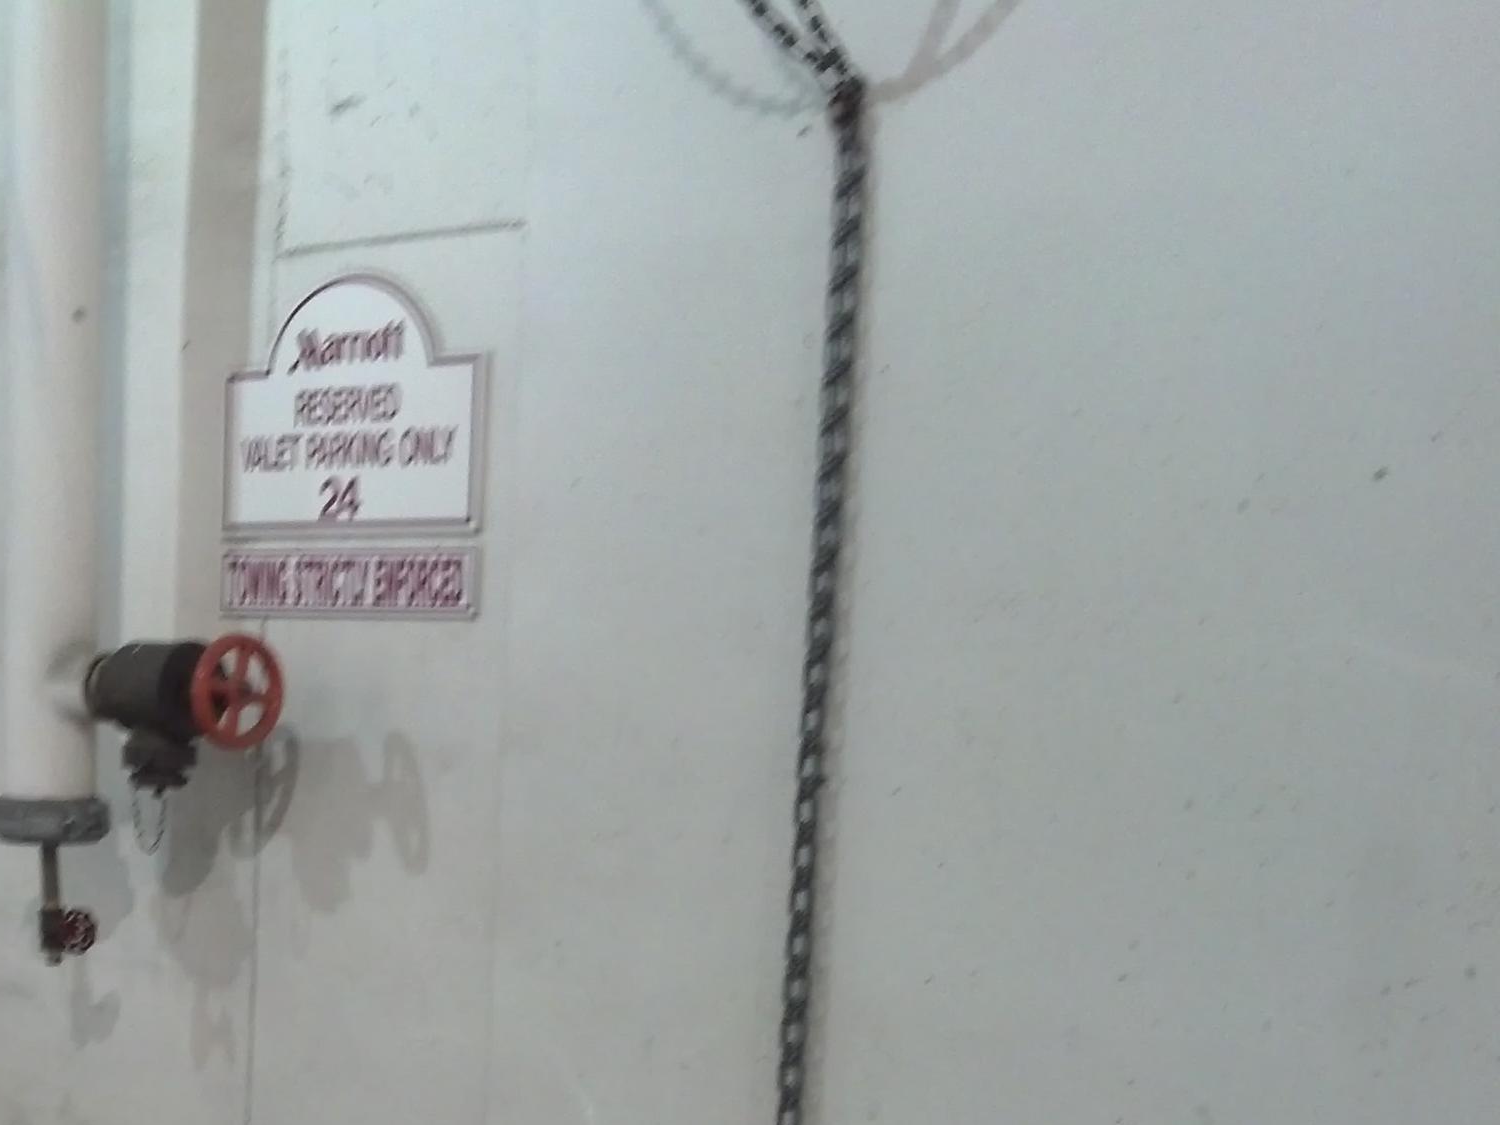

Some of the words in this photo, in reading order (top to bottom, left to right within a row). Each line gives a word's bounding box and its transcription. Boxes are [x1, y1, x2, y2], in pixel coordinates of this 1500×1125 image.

[294, 384, 402, 427] RESERVED
[241, 433, 301, 472] VALET
[303, 429, 395, 470] PARKING
[399, 425, 458, 468] ONLY
[318, 475, 362, 521] 24
